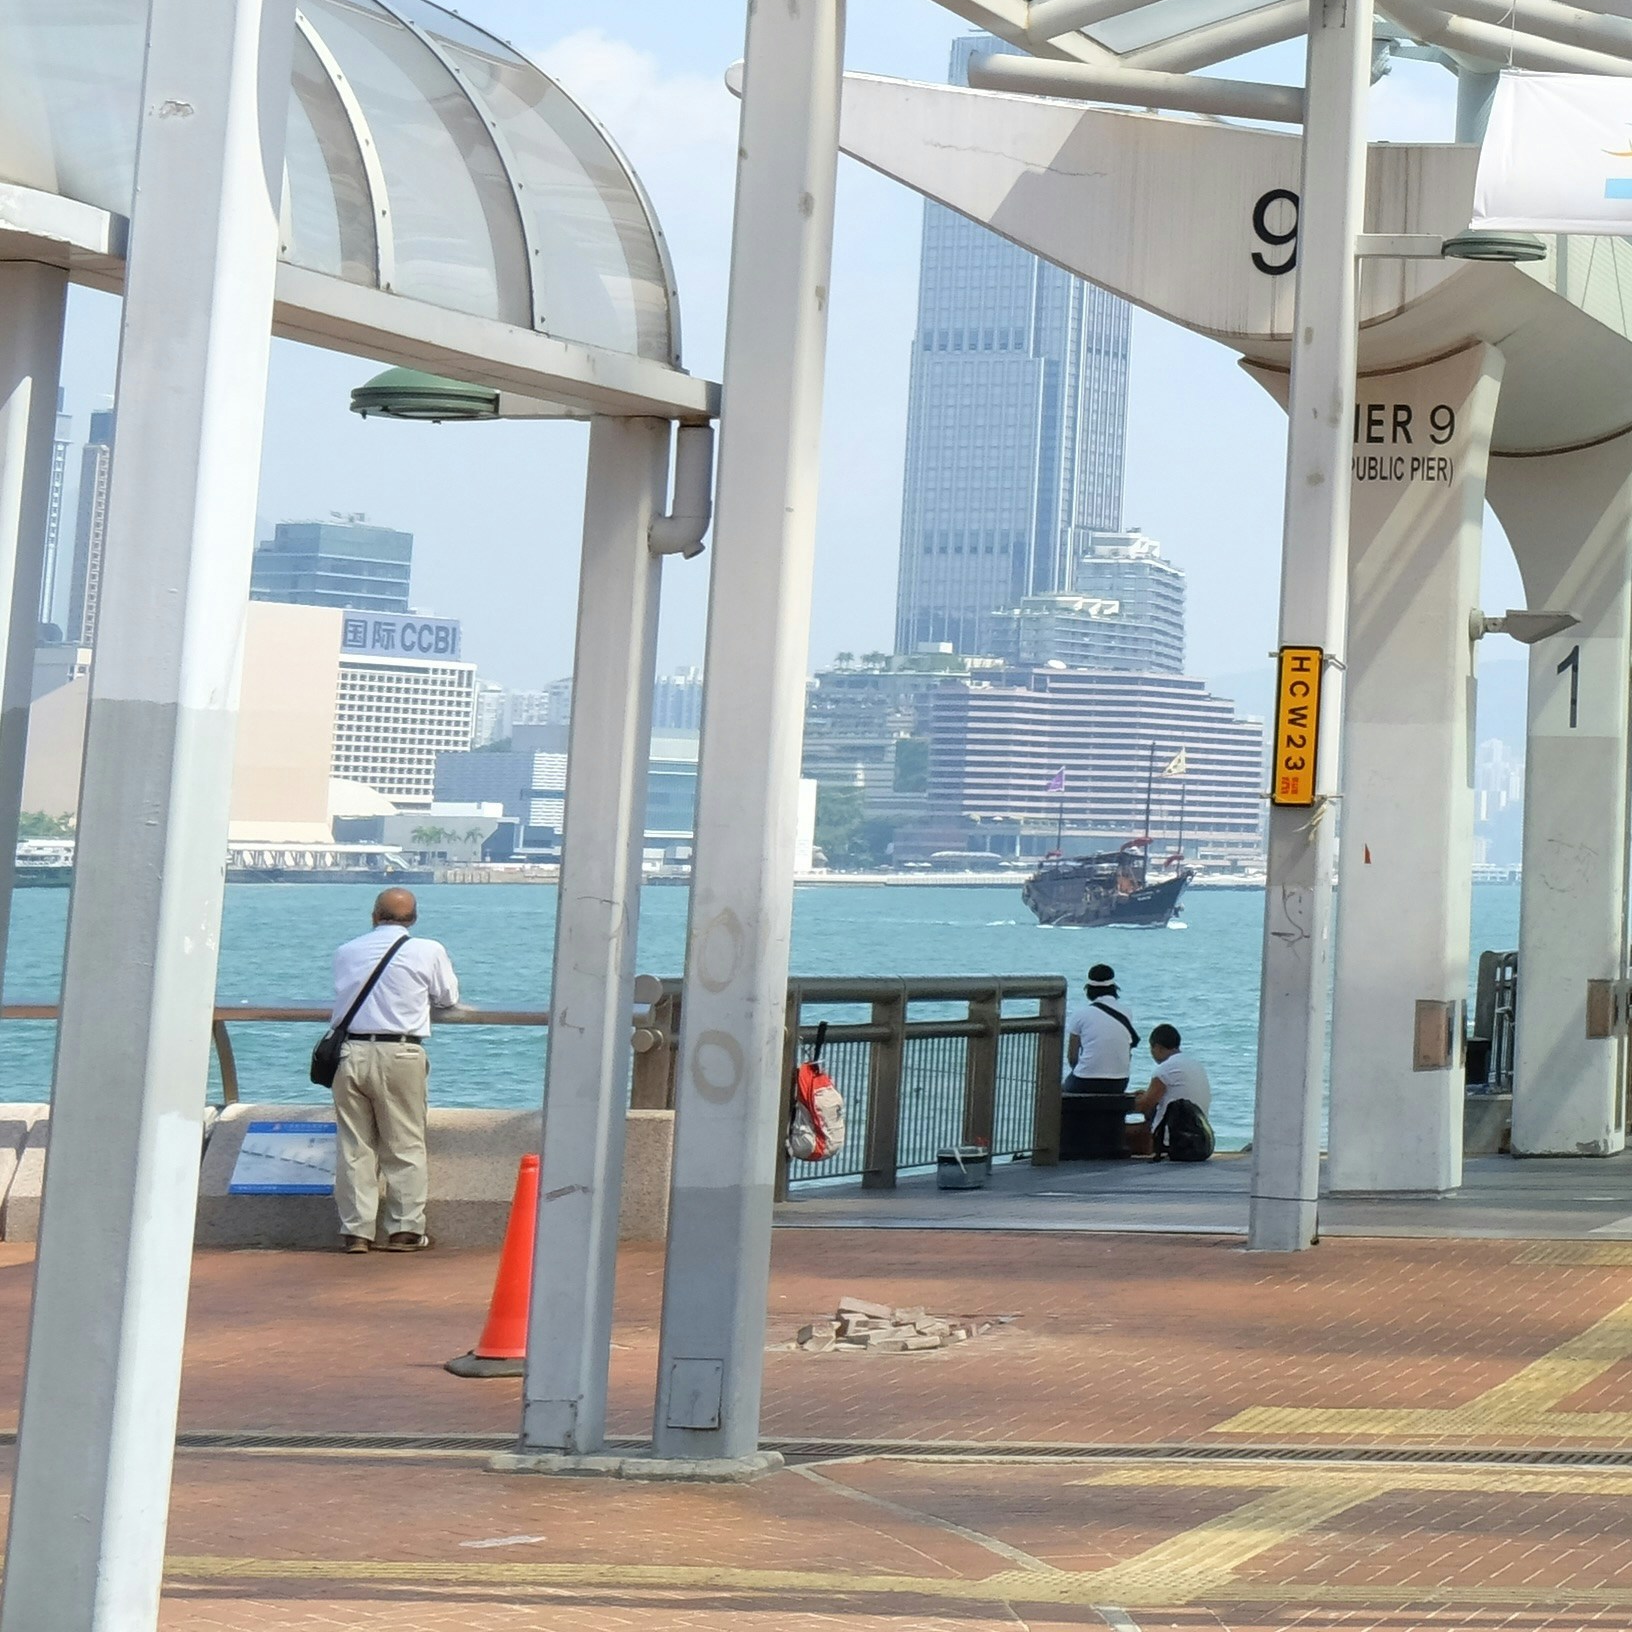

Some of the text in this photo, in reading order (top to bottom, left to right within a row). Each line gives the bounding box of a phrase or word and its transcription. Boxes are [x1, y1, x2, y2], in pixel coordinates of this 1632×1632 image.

[1251, 189, 1299, 275] 9
[1429, 404, 1455, 445] 9
[1410, 457, 1453, 487] PIER)
[343, 619, 457, 655] 国际 CCBI
[1284, 656, 1311, 771] HCW23
[1556, 645, 1580, 729] 1
